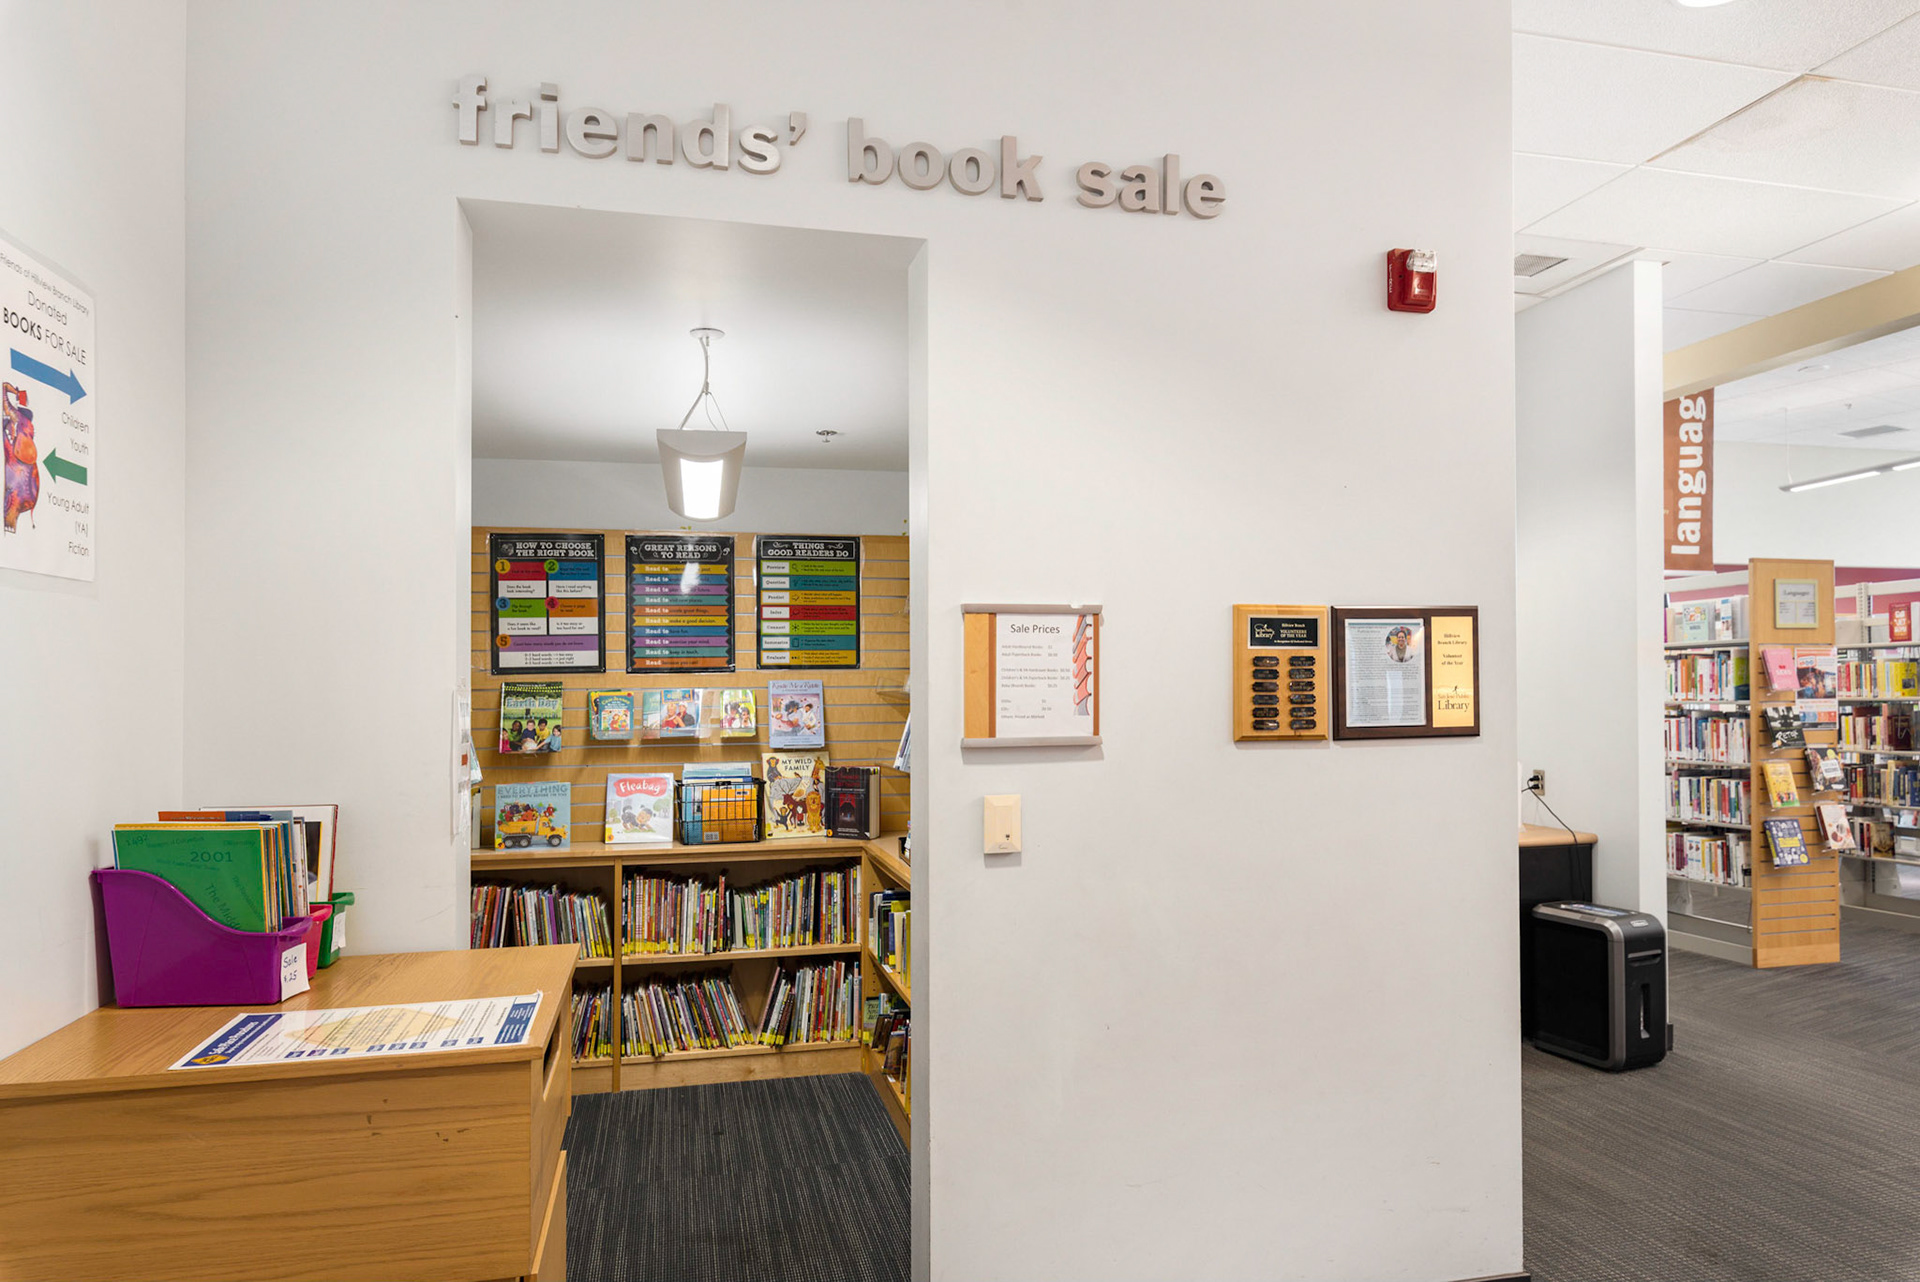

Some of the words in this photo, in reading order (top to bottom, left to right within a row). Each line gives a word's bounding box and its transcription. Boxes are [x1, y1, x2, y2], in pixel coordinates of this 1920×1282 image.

[847, 117, 1044, 202] book
[1075, 153, 1226, 219] sale
[52, 285, 71, 304] Branch
[72, 297, 89, 316] Library
[27, 290, 68, 326] Donated
[3, 307, 42, 341] BOOKS
[45, 328, 64, 354] FOR
[66, 340, 87, 366] SALE
[61, 411, 89, 434] Children
[70, 437, 89, 456] Youth
[47, 491, 70, 512] Young
[71, 499, 89, 515] Adult
[75, 520, 88, 538] (YA)
[68, 541, 89, 557] Fiction
[555, 542, 592, 550] CHOOSE
[644, 544, 675, 552] GREAT
[677, 544, 717, 552] REASONS
[500, 561, 505, 571] 1
[548, 561, 556, 572] 2
[499, 599, 507, 608] 3
[548, 599, 556, 609] 4
[1010, 624, 1030, 633] Sale
[1032, 624, 1060, 634] Prices
[500, 636, 508, 646] 5
[506, 697, 536, 708] Earth
[538, 696, 558, 710] Day
[1438, 700, 1470, 712] Library
[498, 785, 568, 795] EVERYTHING
[619, 780, 661, 795] Fleabag
[126, 834, 148, 846] 1492
[190, 851, 233, 863] 2001
[205, 882, 220, 903] The
[283, 955, 298, 968] Sale
